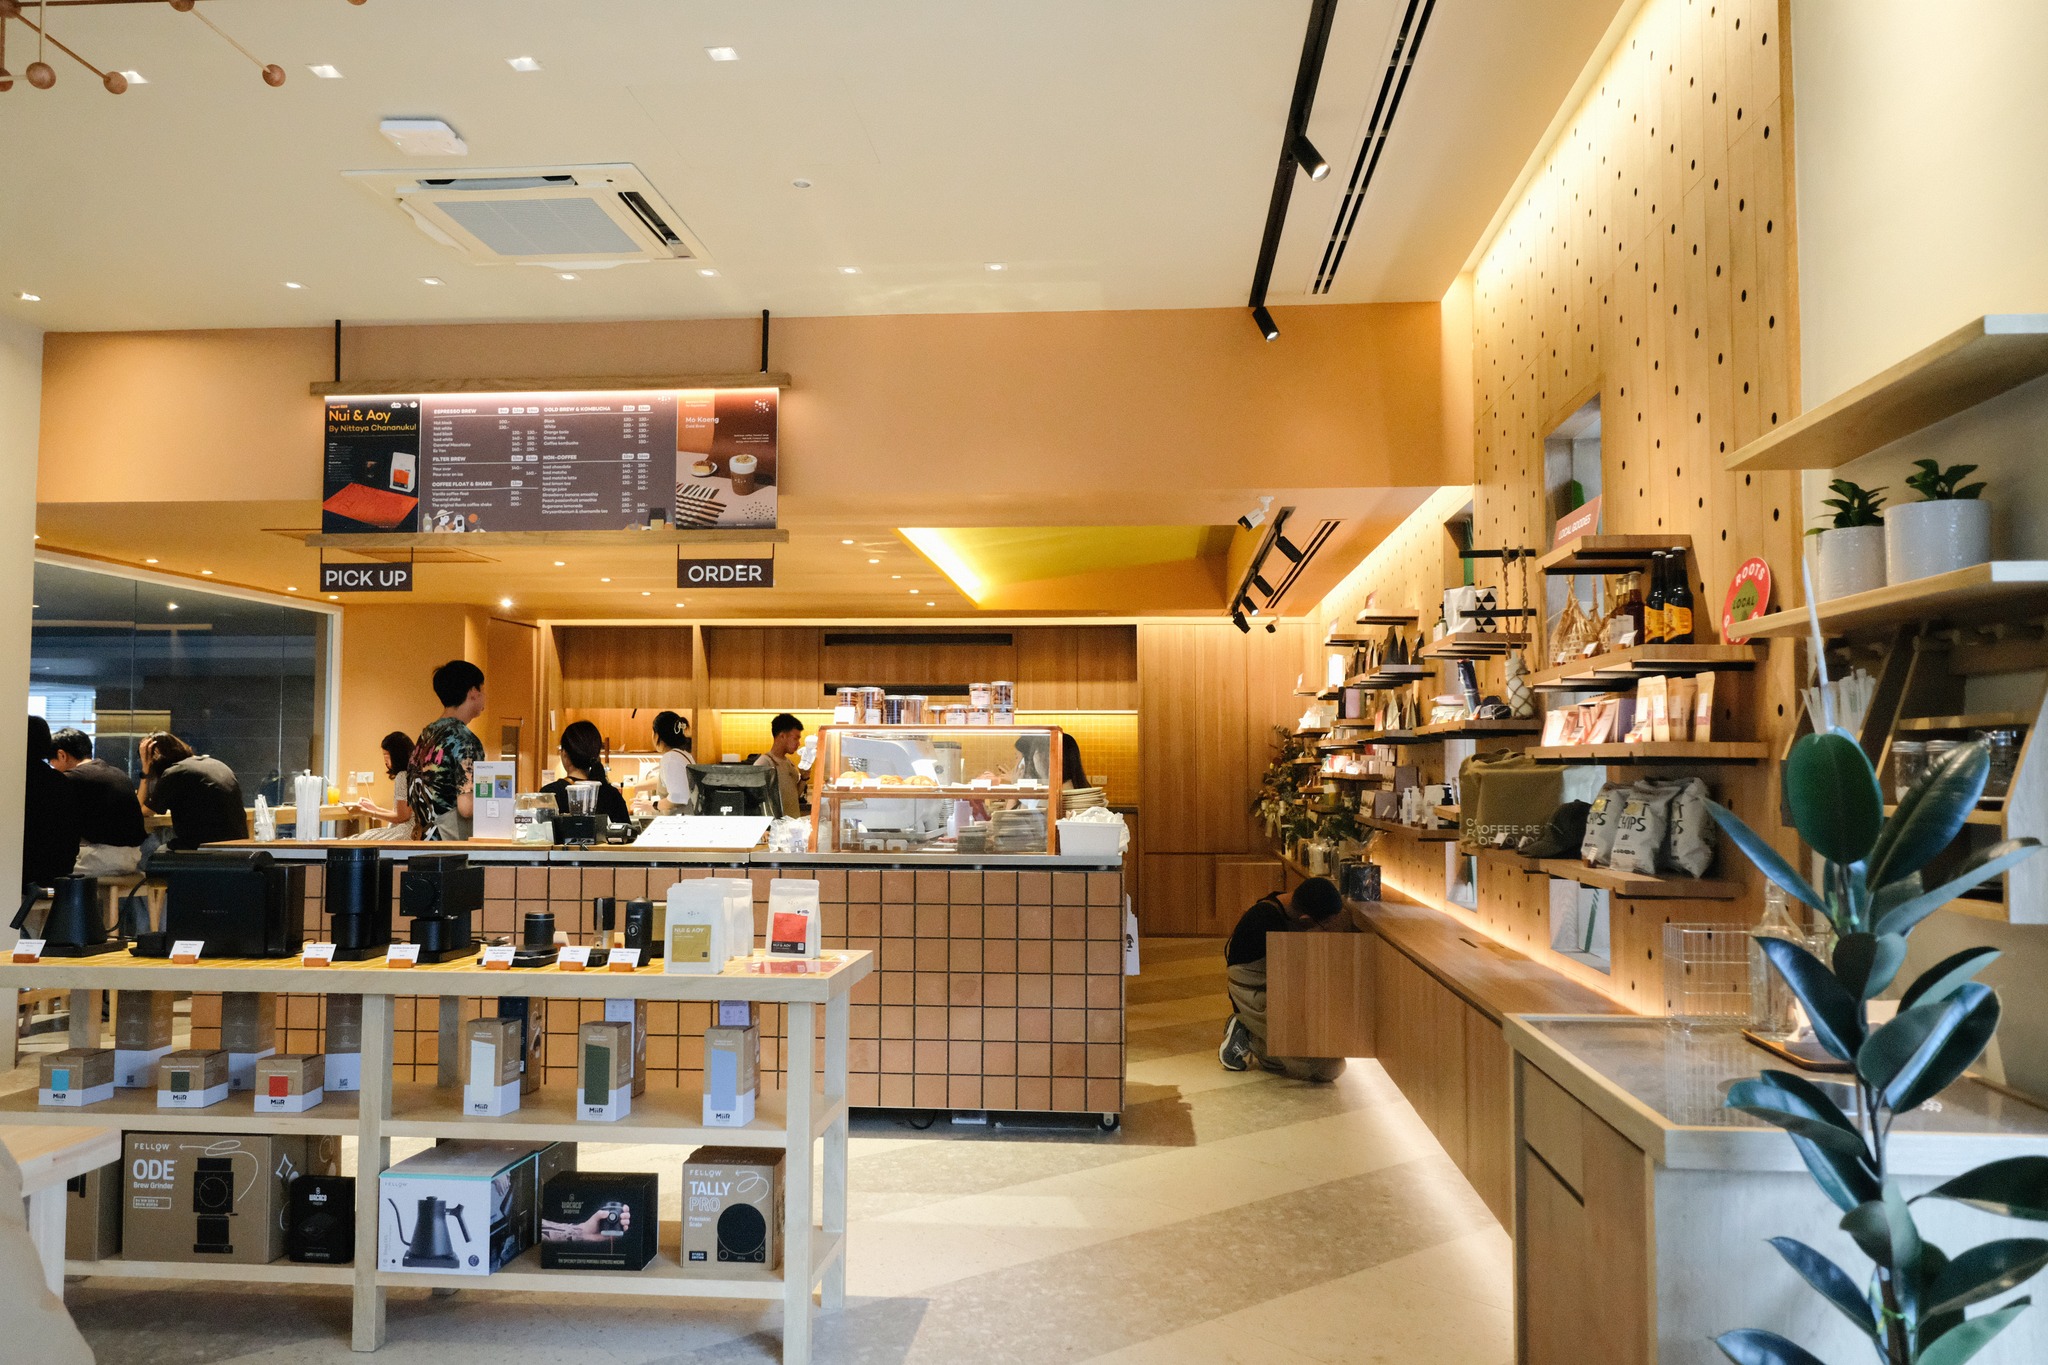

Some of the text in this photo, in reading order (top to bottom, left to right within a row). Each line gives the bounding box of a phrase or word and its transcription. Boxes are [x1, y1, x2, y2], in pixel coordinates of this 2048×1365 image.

[329, 409, 391, 424] Nui & Aoy
[329, 423, 417, 433] By Nittaya Chananukul
[1558, 513, 1592, 540] LOCAL GOODIES
[325, 570, 407, 586] PICK UP
[688, 565, 762, 582] ORDER
[1736, 562, 1766, 587] ROOTS
[1732, 596, 1755, 610] LOCAL
[1618, 815, 1646, 832] CHIPS
[134, 1143, 170, 1152] FELLOW
[133, 1158, 175, 1181] ODE
[689, 1169, 722, 1178] FELLOW
[133, 1181, 174, 1190] Brew Grinder
[689, 1181, 731, 1196] TALLY
[689, 1197, 721, 1212] PRO
